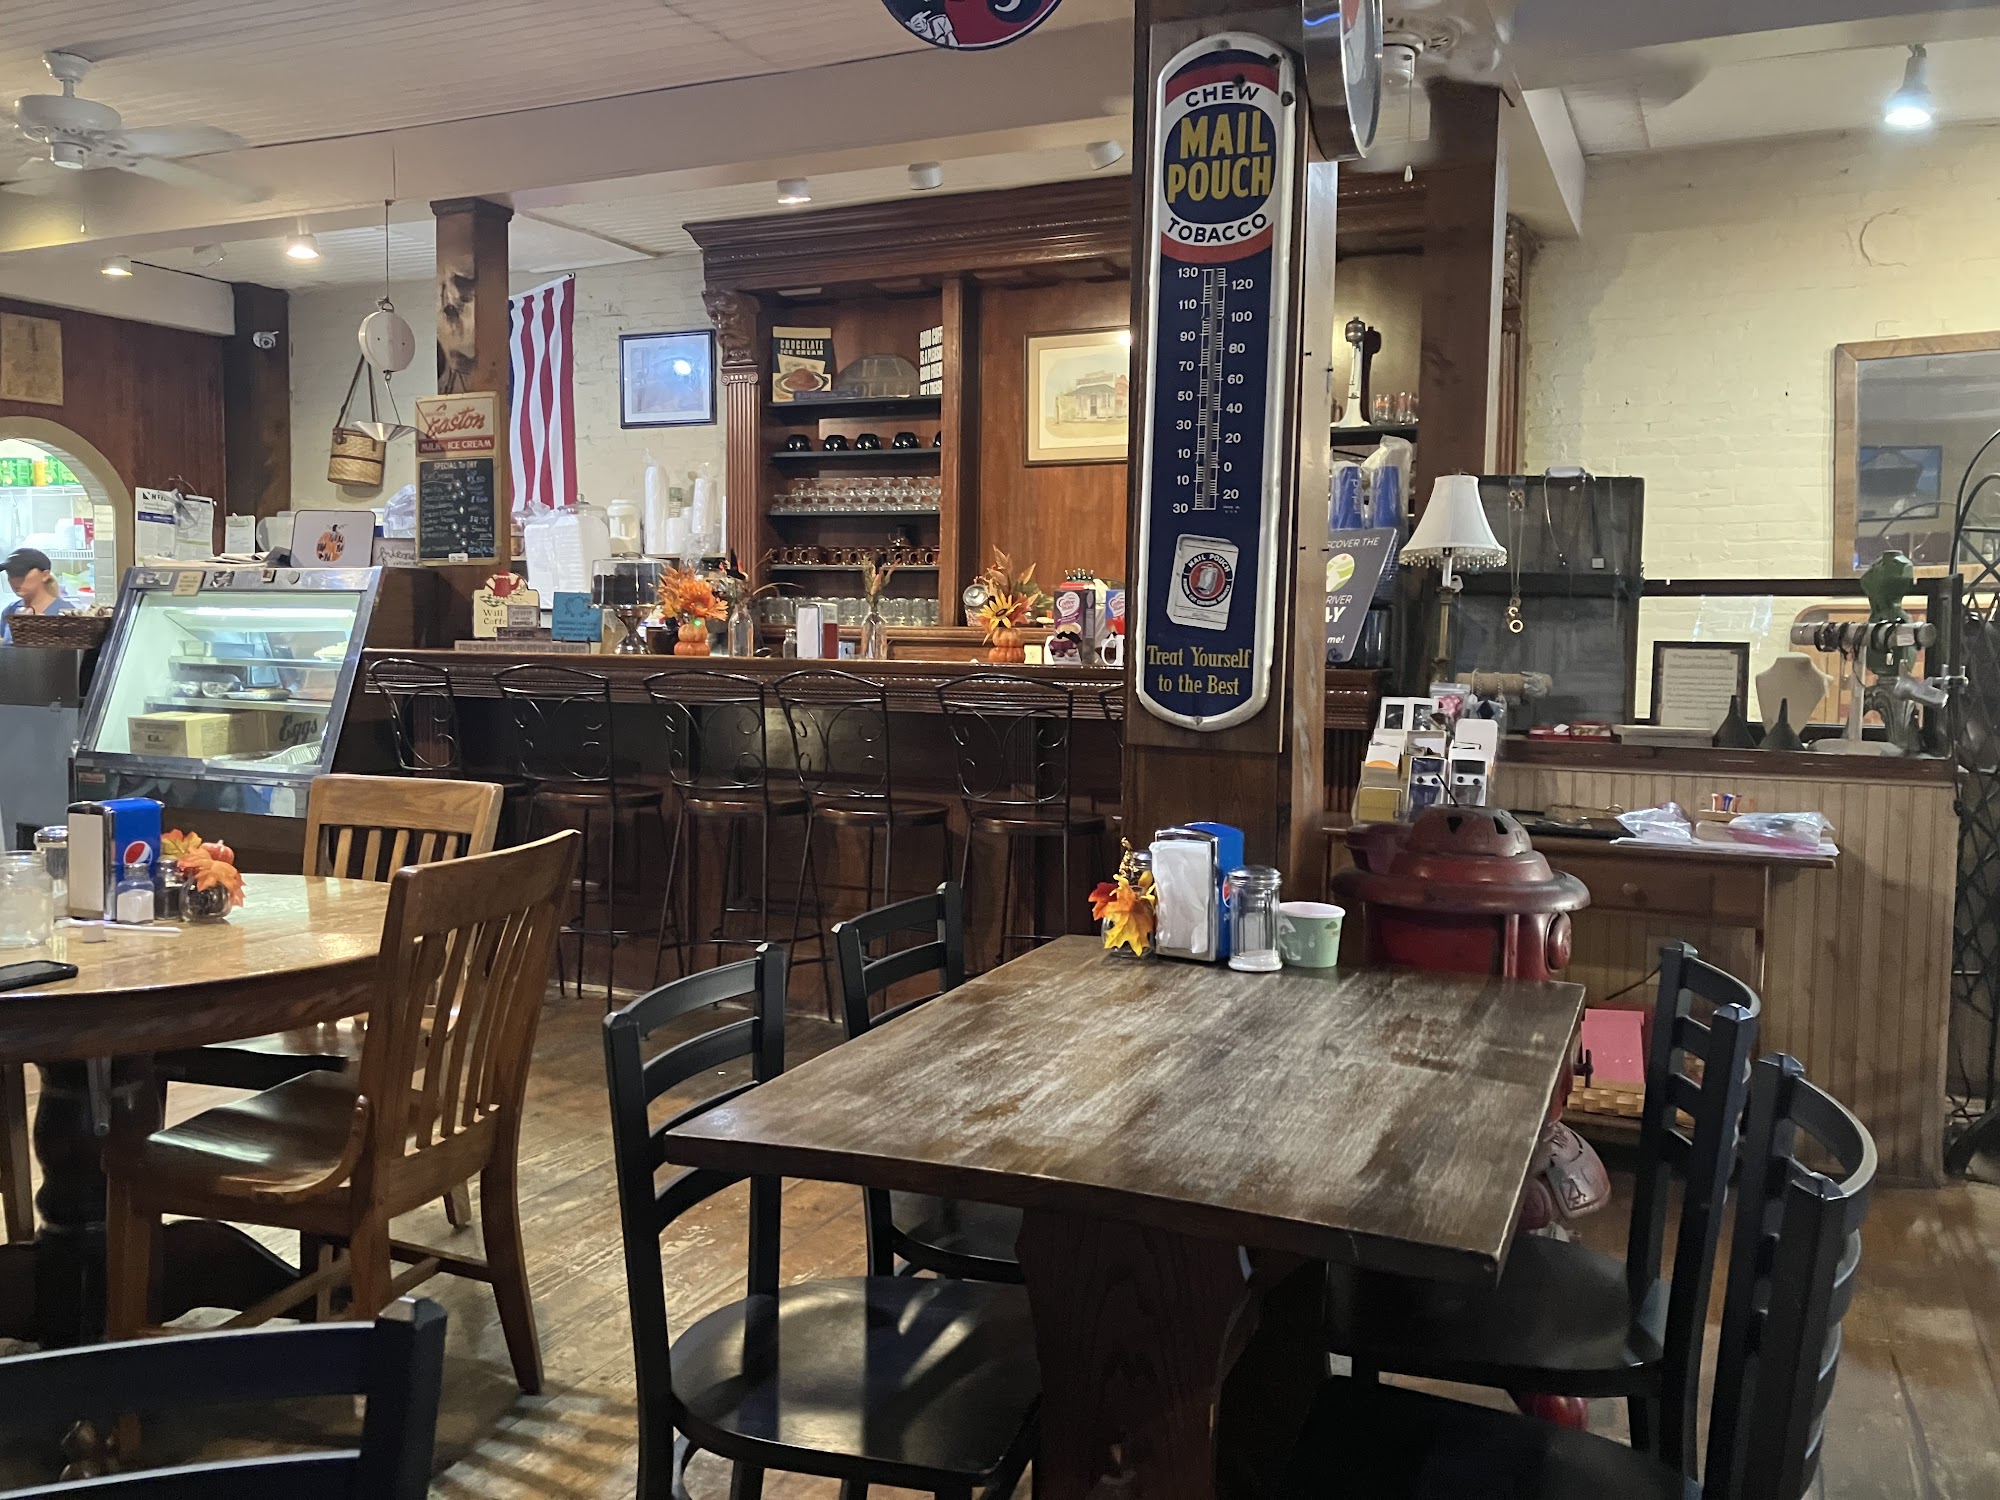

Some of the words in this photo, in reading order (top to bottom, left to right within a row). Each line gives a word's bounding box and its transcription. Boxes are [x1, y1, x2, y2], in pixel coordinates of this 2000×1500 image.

[1185, 84, 1260, 107] CHEW
[1179, 110, 1269, 160] MAIL
[1167, 155, 1272, 204] POUCH
[1167, 213, 1267, 243] TOBACCO
[1178, 267, 1198, 278] 130
[1232, 279, 1254, 290] 120
[1178, 299, 1197, 310] 110
[1230, 311, 1252, 322] 100
[1180, 332, 1196, 342] 90
[780, 339, 824, 350] CHOCOLATE
[1228, 343, 1245, 354] 80
[1178, 361, 1194, 371] 70
[1228, 374, 1244, 384] 60
[1177, 391, 1193, 401] 50
[1226, 403, 1243, 414] 40
[1176, 420, 1192, 430] 30
[1224, 433, 1241, 443] 20
[447, 441, 460, 450] ICE
[462, 440, 492, 448] CREAM
[1178, 449, 1190, 458] 10
[1224, 462, 1232, 472] 0
[1176, 476, 1190, 485] 10
[1222, 489, 1239, 500] 20
[1172, 504, 1189, 513] 30
[1362, 536, 1380, 546] THE
[1326, 594, 1352, 604] RIVER
[484, 617, 507, 625] Coffe
[1327, 634, 1345, 644] me!
[1147, 645, 1184, 666] Treat
[1190, 646, 1252, 669] Yourself
[1158, 674, 1172, 692] to
[1178, 674, 1203, 693] the
[1207, 675, 1240, 695] Best
[279, 714, 318, 745] Eggs
